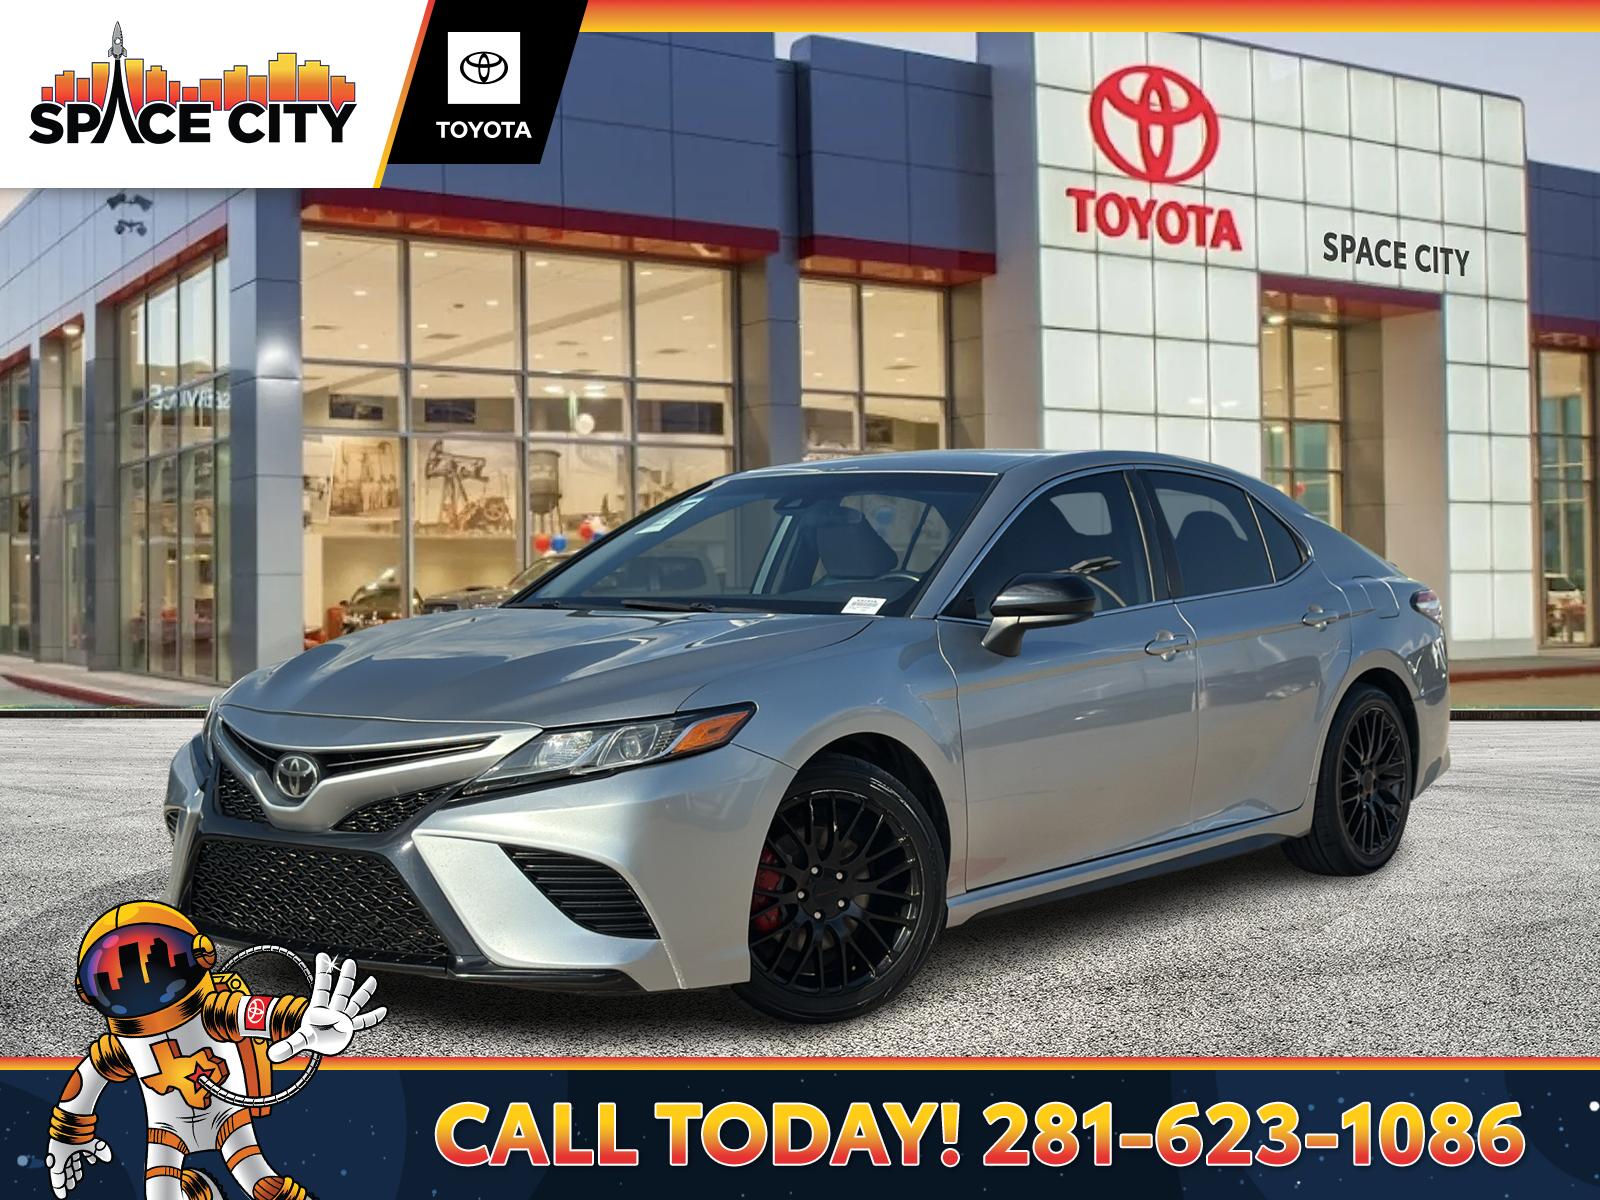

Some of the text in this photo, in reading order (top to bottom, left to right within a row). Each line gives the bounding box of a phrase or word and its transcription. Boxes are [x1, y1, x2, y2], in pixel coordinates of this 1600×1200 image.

[1066, 188, 1242, 251] TOYOTA
[1323, 232, 1470, 277] SPACE CITY
